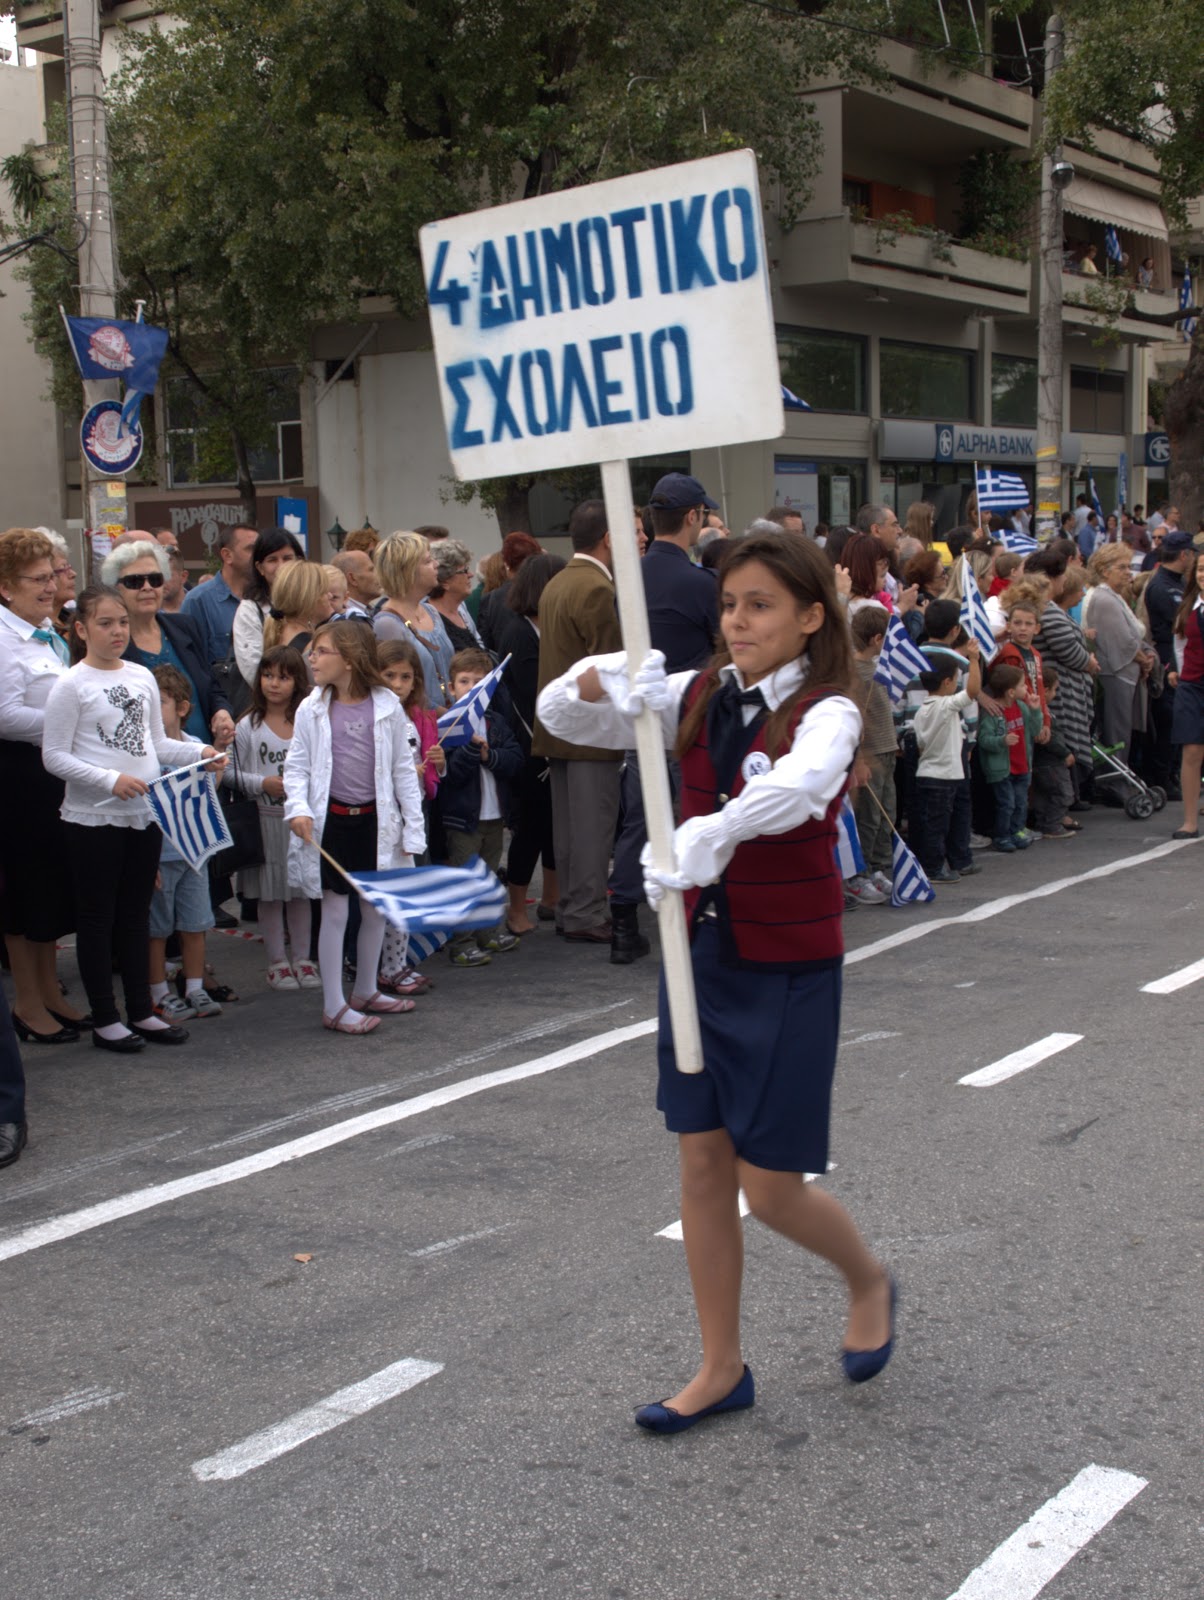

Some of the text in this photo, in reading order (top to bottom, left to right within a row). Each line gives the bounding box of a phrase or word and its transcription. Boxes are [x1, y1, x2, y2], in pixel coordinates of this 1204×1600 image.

[479, 186, 759, 330] ΔΗΜΟΤΙΚΟ
[444, 325, 695, 450] ΣΧΟΛΕΙΟ
[956, 433, 998, 454] ALPHA
[999, 434, 1034, 456] BANK
